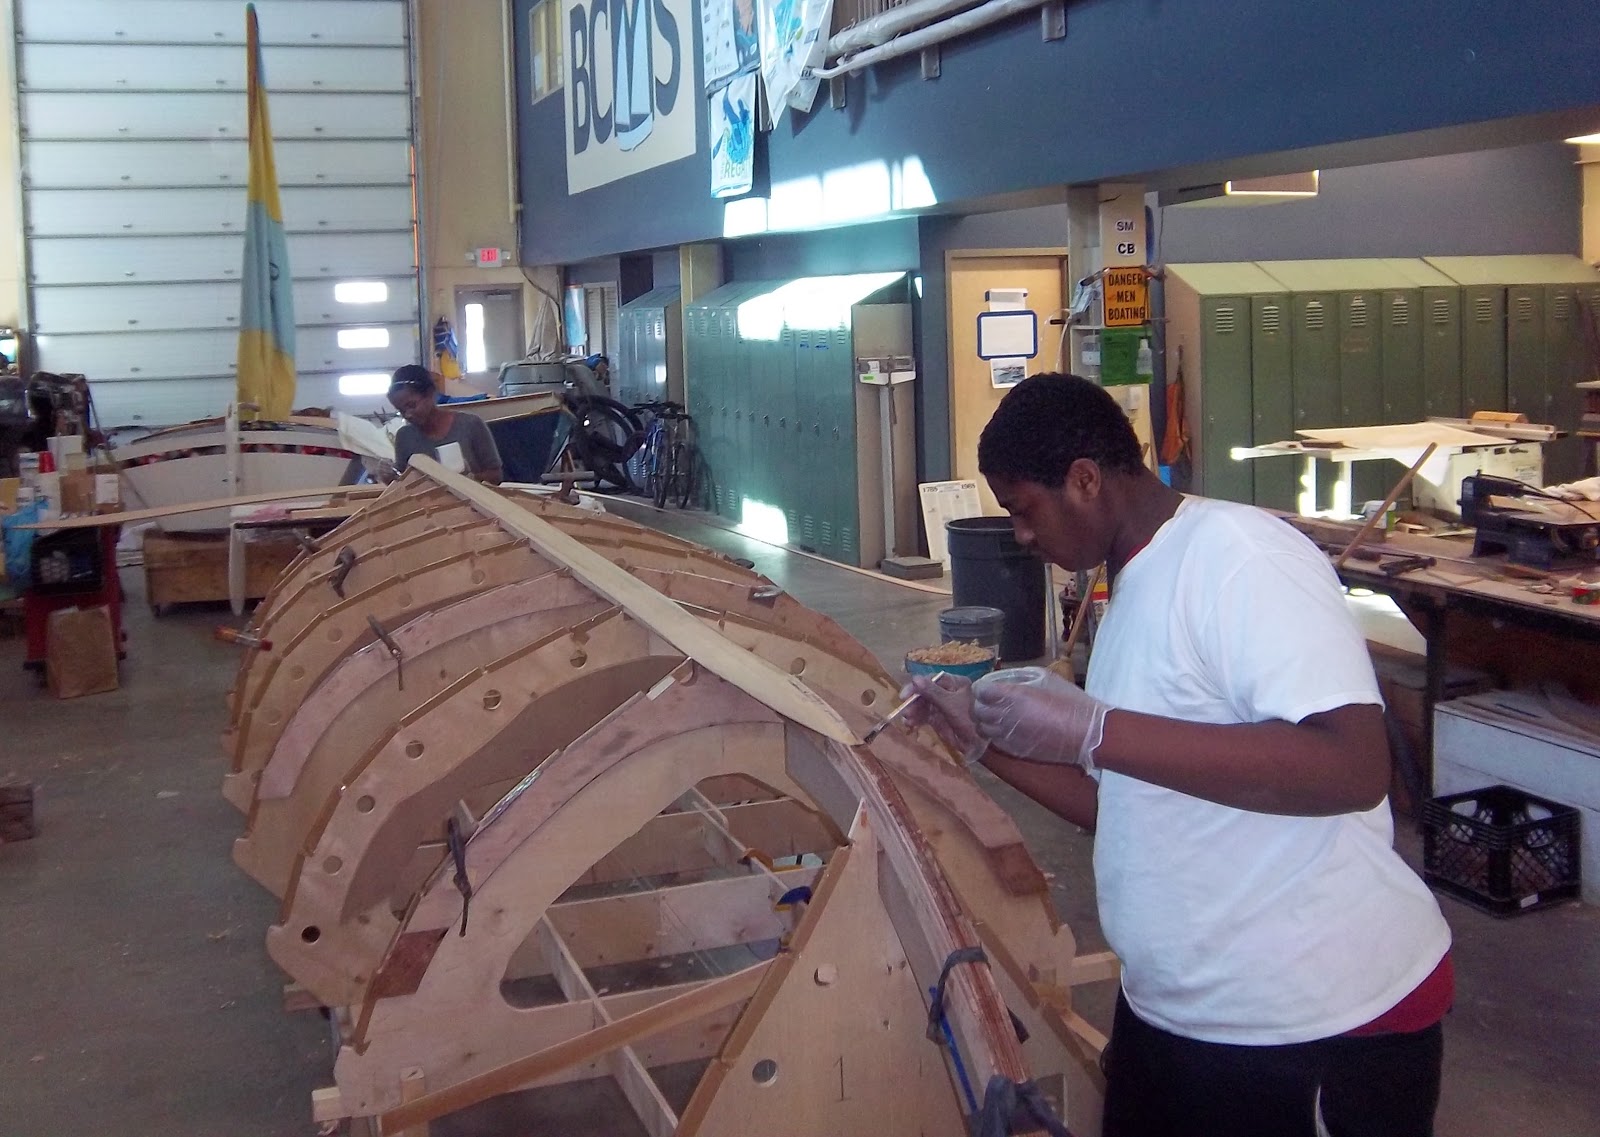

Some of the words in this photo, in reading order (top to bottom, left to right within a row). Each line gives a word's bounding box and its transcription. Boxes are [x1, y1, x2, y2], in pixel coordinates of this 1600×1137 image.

[569, 0, 681, 155] BCMS
[1116, 221, 1134, 232] SM
[1117, 243, 1136, 254] CB
[1108, 273, 1143, 287] DANGER
[1116, 290, 1136, 302] MEN
[1108, 306, 1145, 321] BOATING
